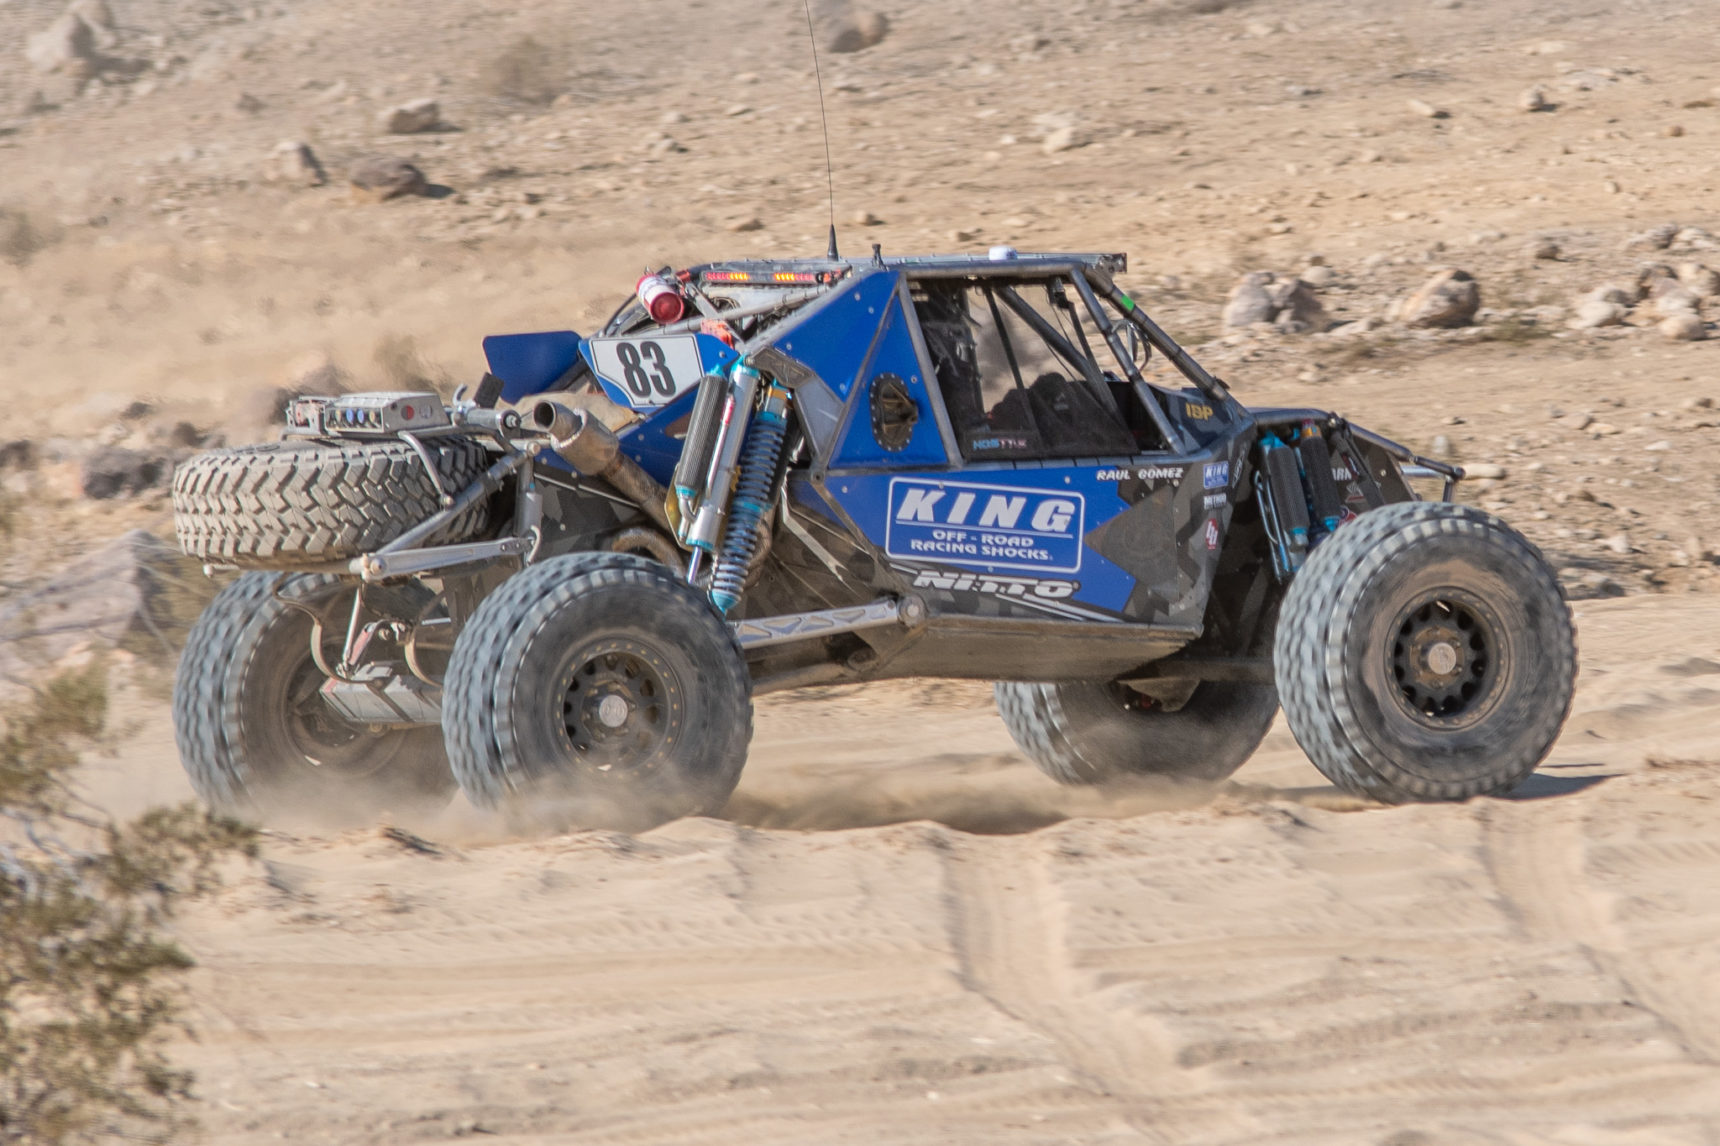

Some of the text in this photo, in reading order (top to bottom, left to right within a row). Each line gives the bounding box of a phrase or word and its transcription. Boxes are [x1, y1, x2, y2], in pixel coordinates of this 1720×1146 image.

[616, 341, 676, 398] 83
[1096, 467, 1184, 481] RAUL GOMEZ
[1206, 464, 1228, 478] KING
[896, 488, 1076, 533] KING
[911, 539, 977, 555] RACING
[932, 529, 967, 542] OFF
[981, 533, 1034, 547] ROAD
[913, 570, 1073, 598] NITTO
